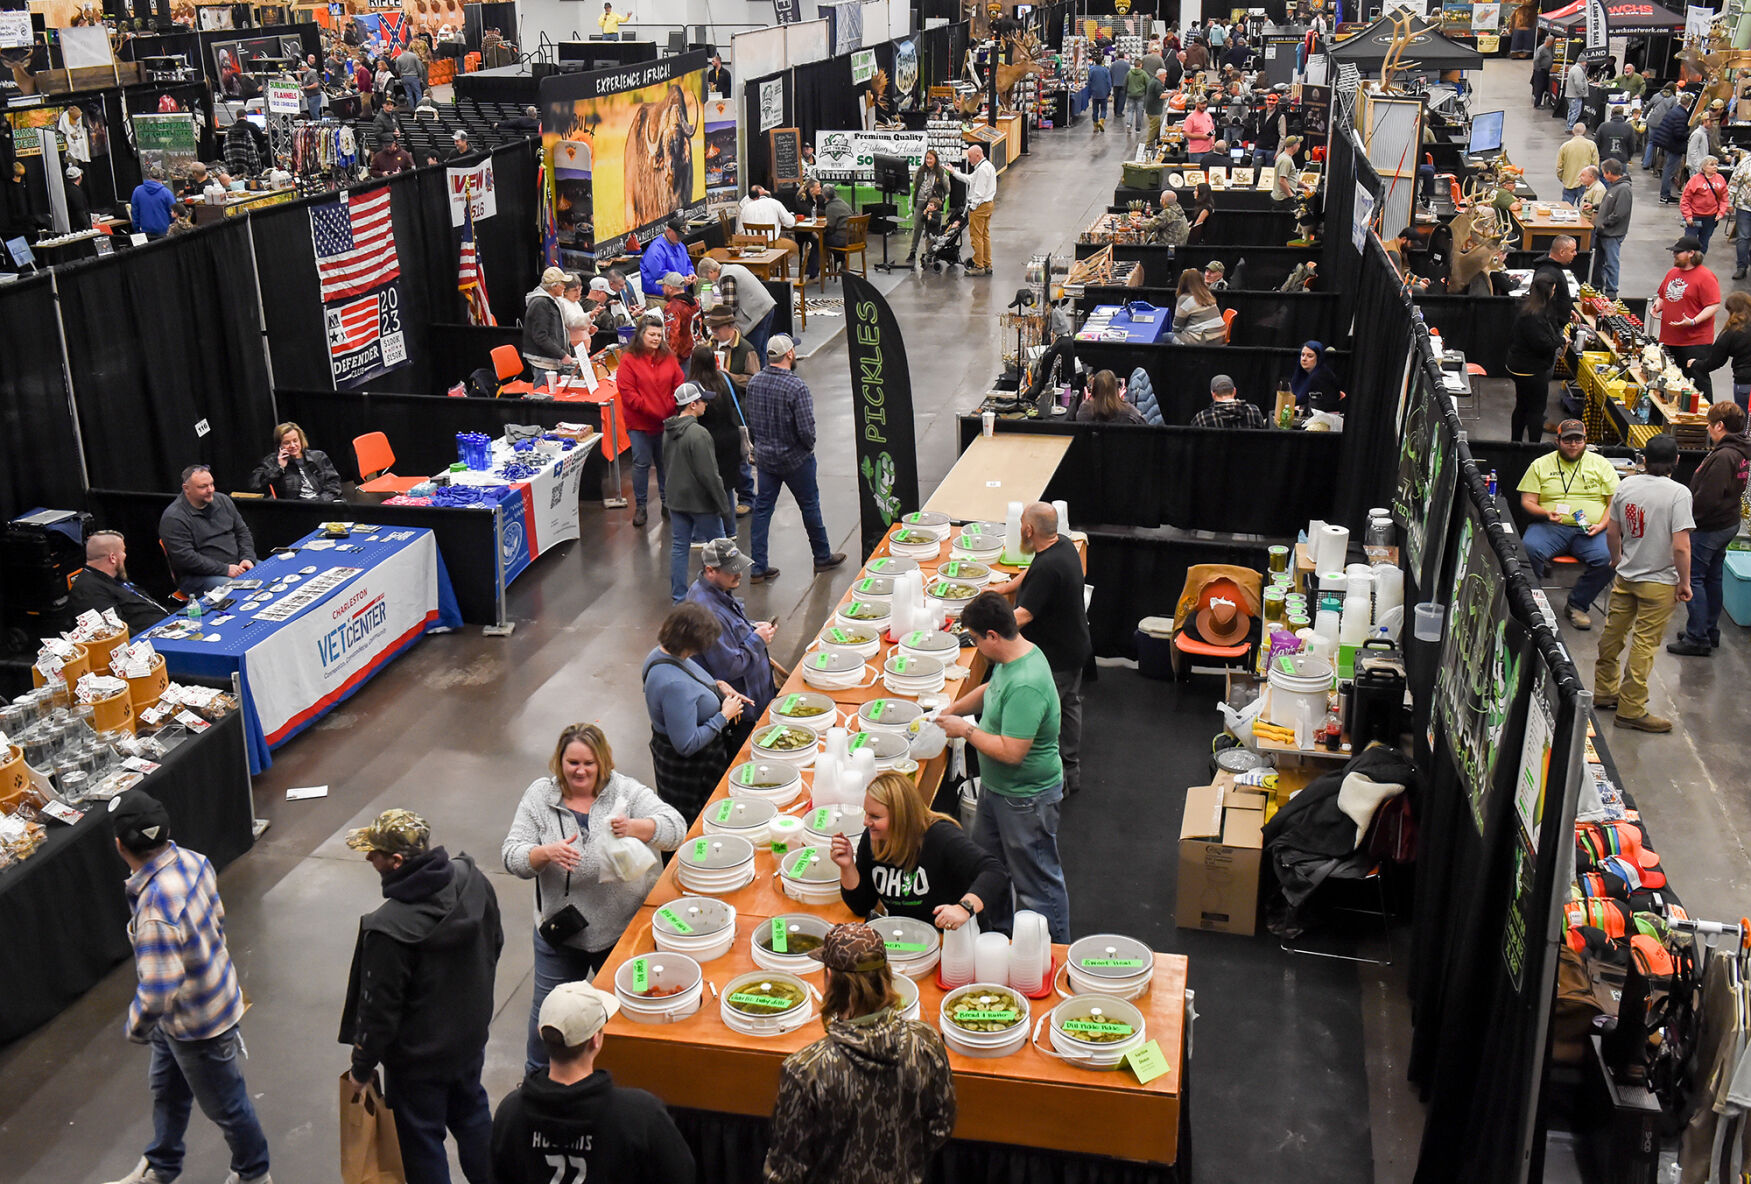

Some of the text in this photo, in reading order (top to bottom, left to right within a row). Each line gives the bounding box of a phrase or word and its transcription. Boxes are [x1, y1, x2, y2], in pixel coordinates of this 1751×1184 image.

[1608, 4, 1654, 13] WCHS
[596, 63, 671, 93] EXPERIENCE AFRICA!
[274, 91, 297, 99] FLANNELS
[854, 133, 923, 142] Premium Quality
[454, 169, 484, 194] VFW
[464, 201, 485, 219] 516
[380, 287, 398, 313] 20
[381, 309, 401, 336] 23
[333, 345, 380, 375] DEFENDER
[856, 301, 887, 443] PICKLES
[332, 587, 368, 620] CHARLESTON
[317, 601, 386, 668] VET CENTER
